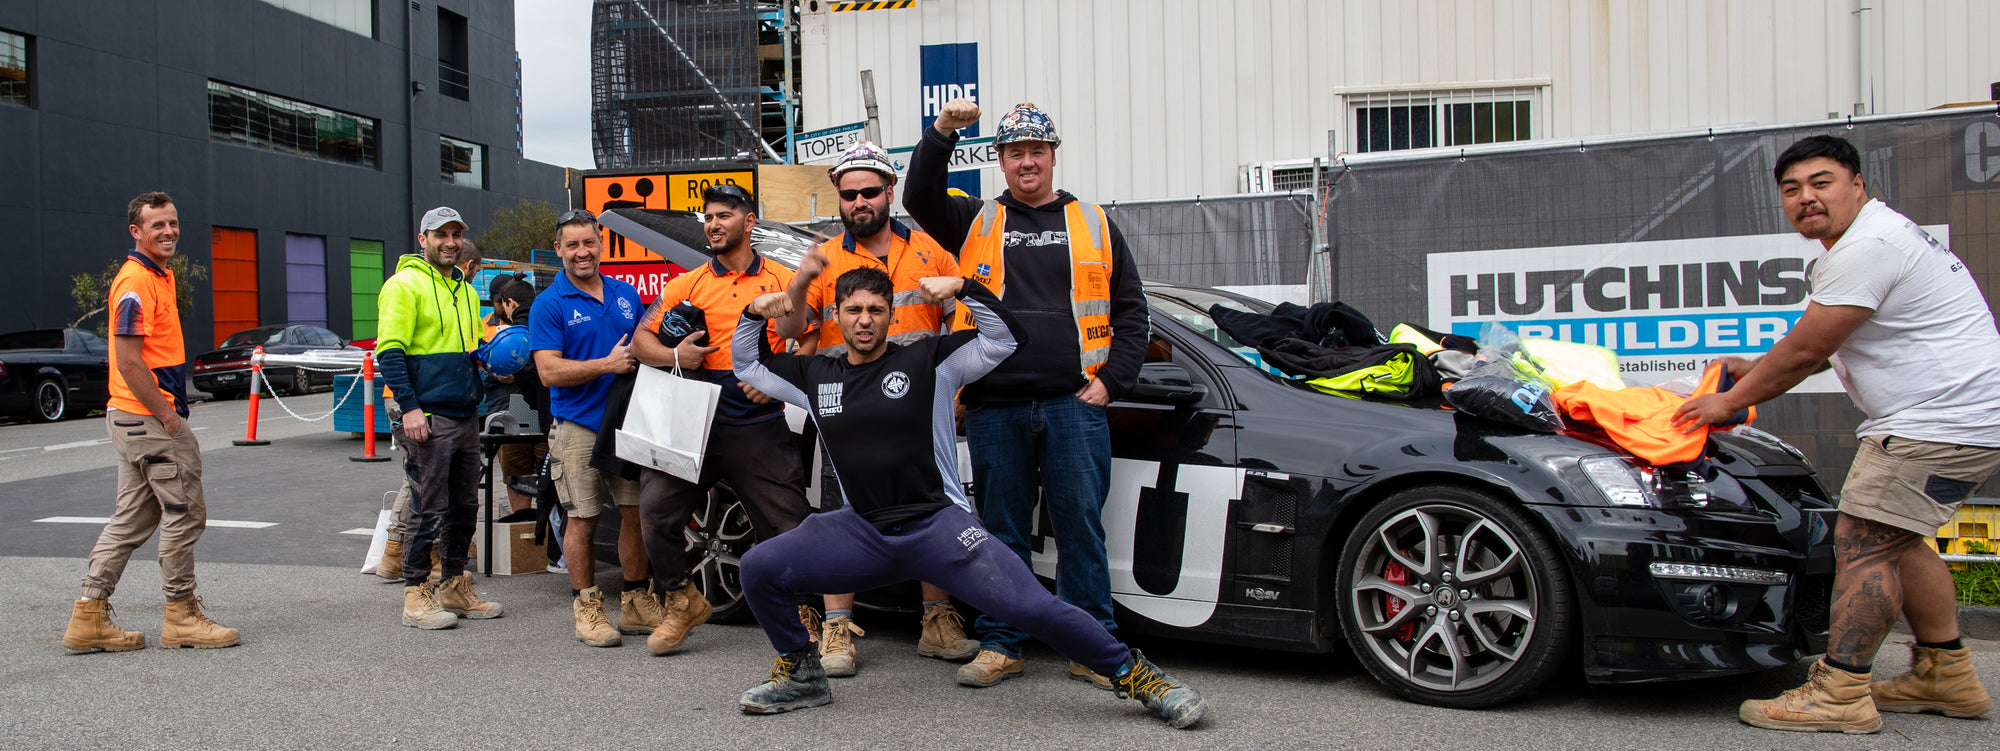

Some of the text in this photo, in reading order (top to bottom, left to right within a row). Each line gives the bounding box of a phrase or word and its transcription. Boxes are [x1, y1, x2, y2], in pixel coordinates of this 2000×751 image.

[801, 132, 858, 158] TOPE ST
[950, 146, 998, 166] RKE
[605, 272, 669, 297] PARE
[1450, 257, 1813, 317] HUTCHINS
[1518, 317, 1801, 353] BUILDER
[1619, 359, 1697, 373] stablished
[818, 382, 843, 395] UNION
[818, 393, 842, 408] BUILT
